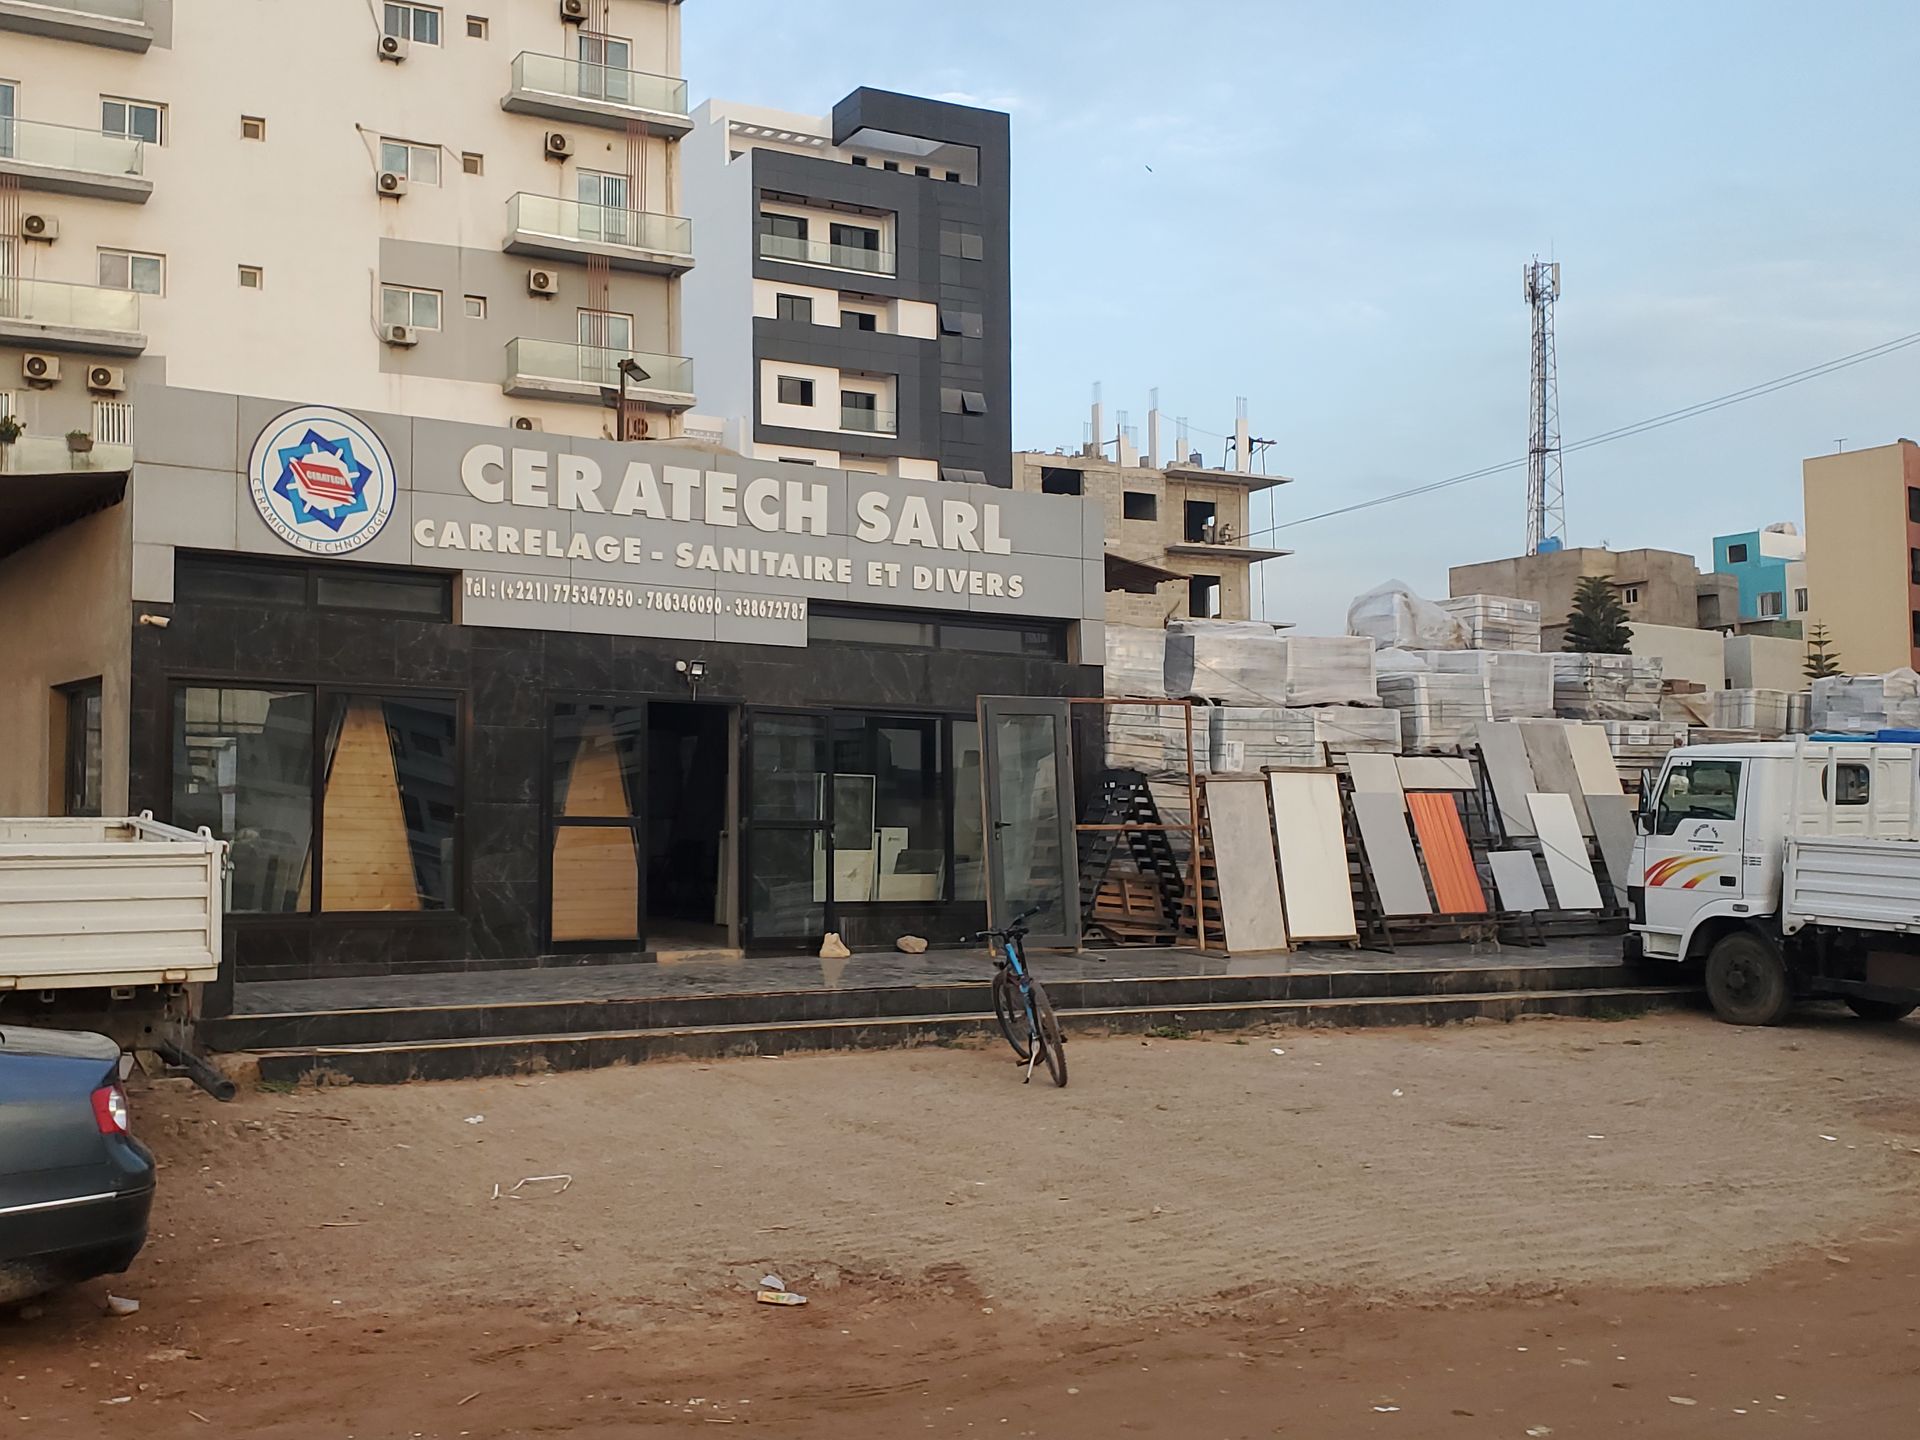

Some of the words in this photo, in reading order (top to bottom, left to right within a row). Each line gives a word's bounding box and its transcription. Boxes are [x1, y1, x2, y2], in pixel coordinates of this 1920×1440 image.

[252, 477, 301, 544] CERAMIQUE
[308, 507, 388, 552] TECHNOLOGIE
[461, 443, 828, 537] CERATECH
[855, 491, 1011, 555] SARL
[413, 518, 641, 565] CARRELAGE
[676, 542, 852, 585] SANITAIRE
[868, 560, 900, 587] ET
[913, 565, 1024, 599] DIVERS
[465, 577, 486, 597] Tél
[501, 580, 548, 603] (+221)
[553, 584, 633, 608] 775347950
[646, 591, 722, 614] 786346090
[735, 599, 806, 620] 338672787
